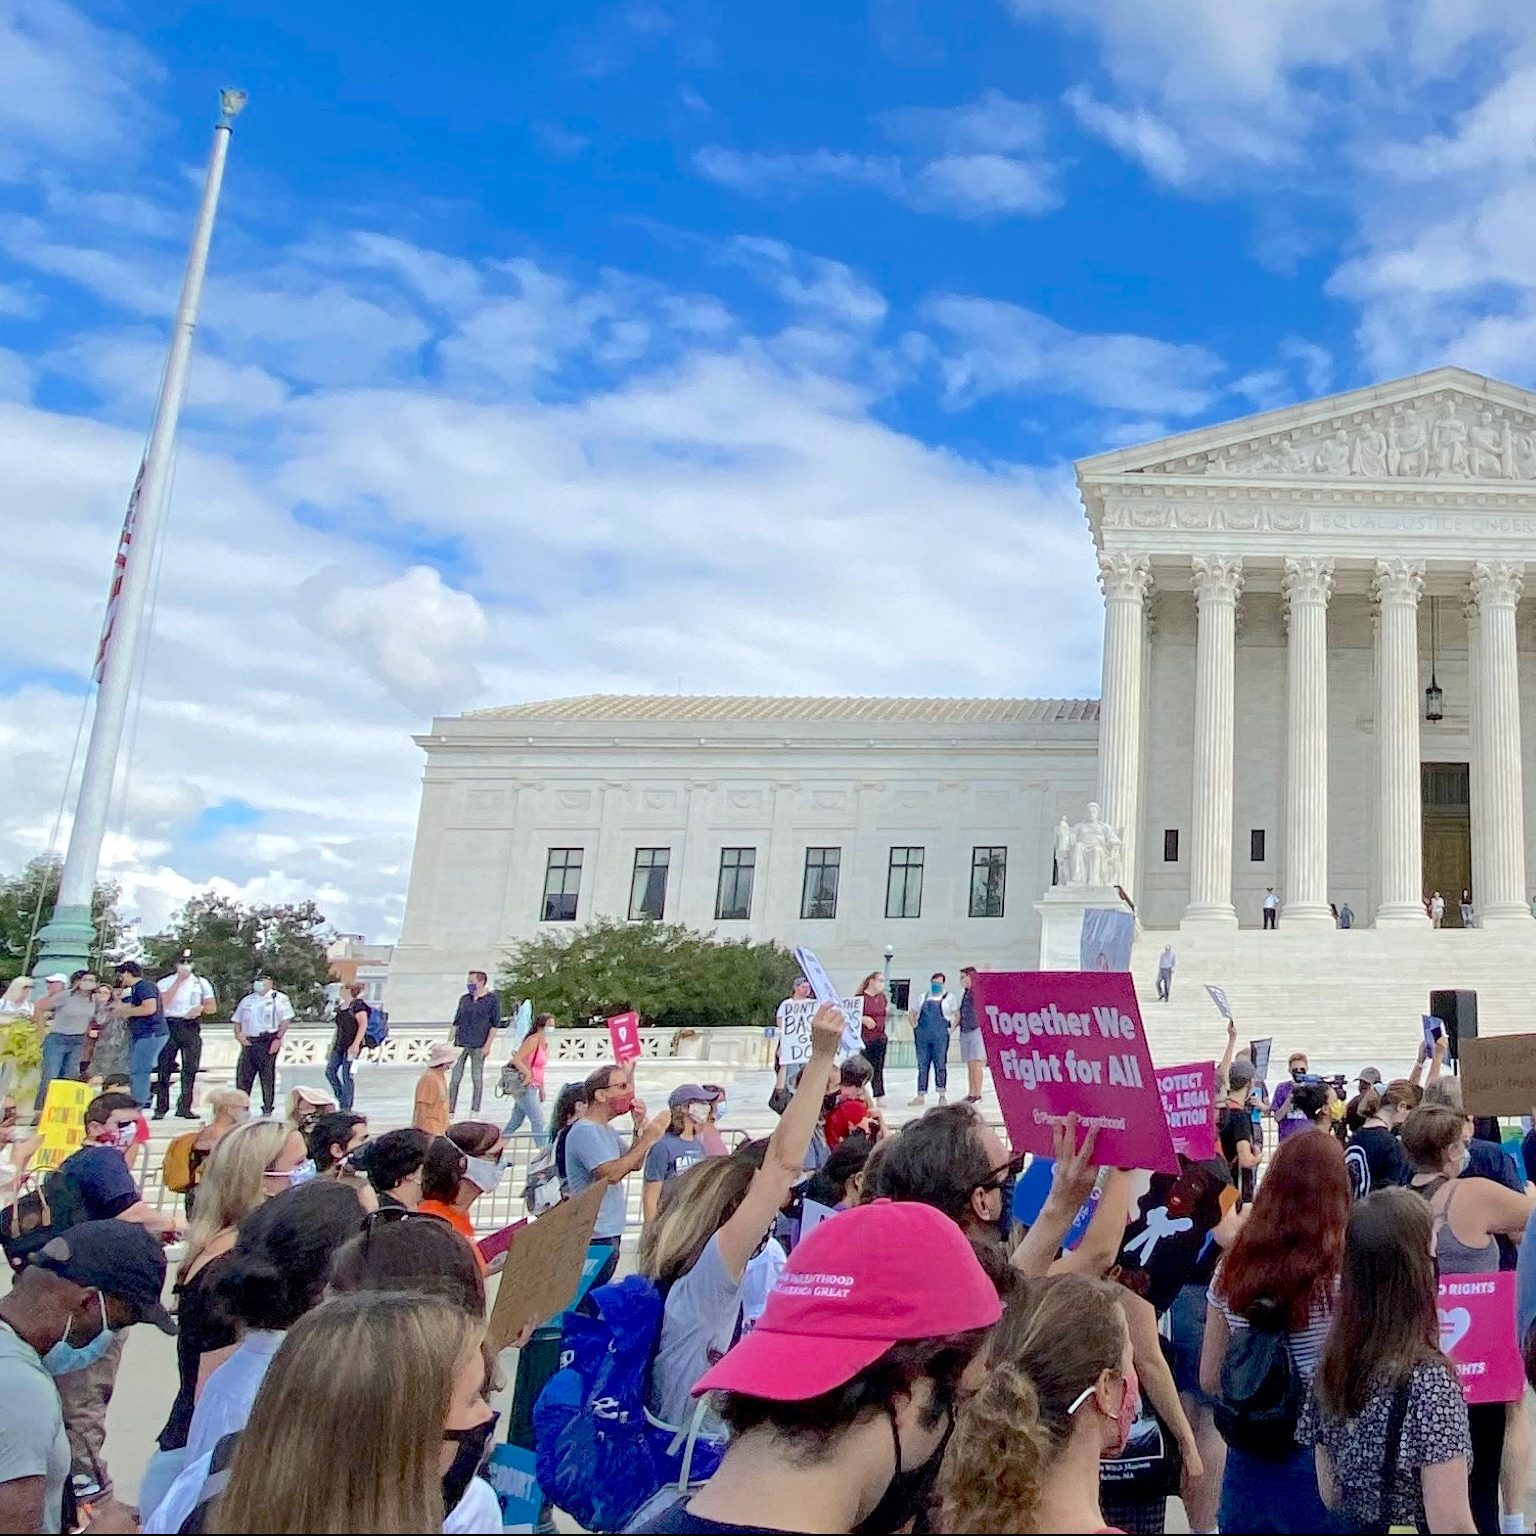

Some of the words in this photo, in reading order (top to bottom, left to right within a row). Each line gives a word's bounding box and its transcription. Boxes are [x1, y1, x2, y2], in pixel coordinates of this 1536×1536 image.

[1393, 514, 1463, 530] JUSTICE
[1472, 518, 1533, 532] UNDER
[843, 999, 860, 1009] THE
[985, 1003, 1091, 1045] Together
[1092, 1006, 1136, 1040] We
[1001, 1048, 1063, 1091] Fight
[1065, 1050, 1101, 1085] for
[1108, 1054, 1144, 1089] All
[1157, 1072, 1203, 1093] OTECT
[1176, 1089, 1211, 1109] LEGAL
[814, 1286, 850, 1298] GREAT
[1448, 1282, 1496, 1296] RIGHTS
